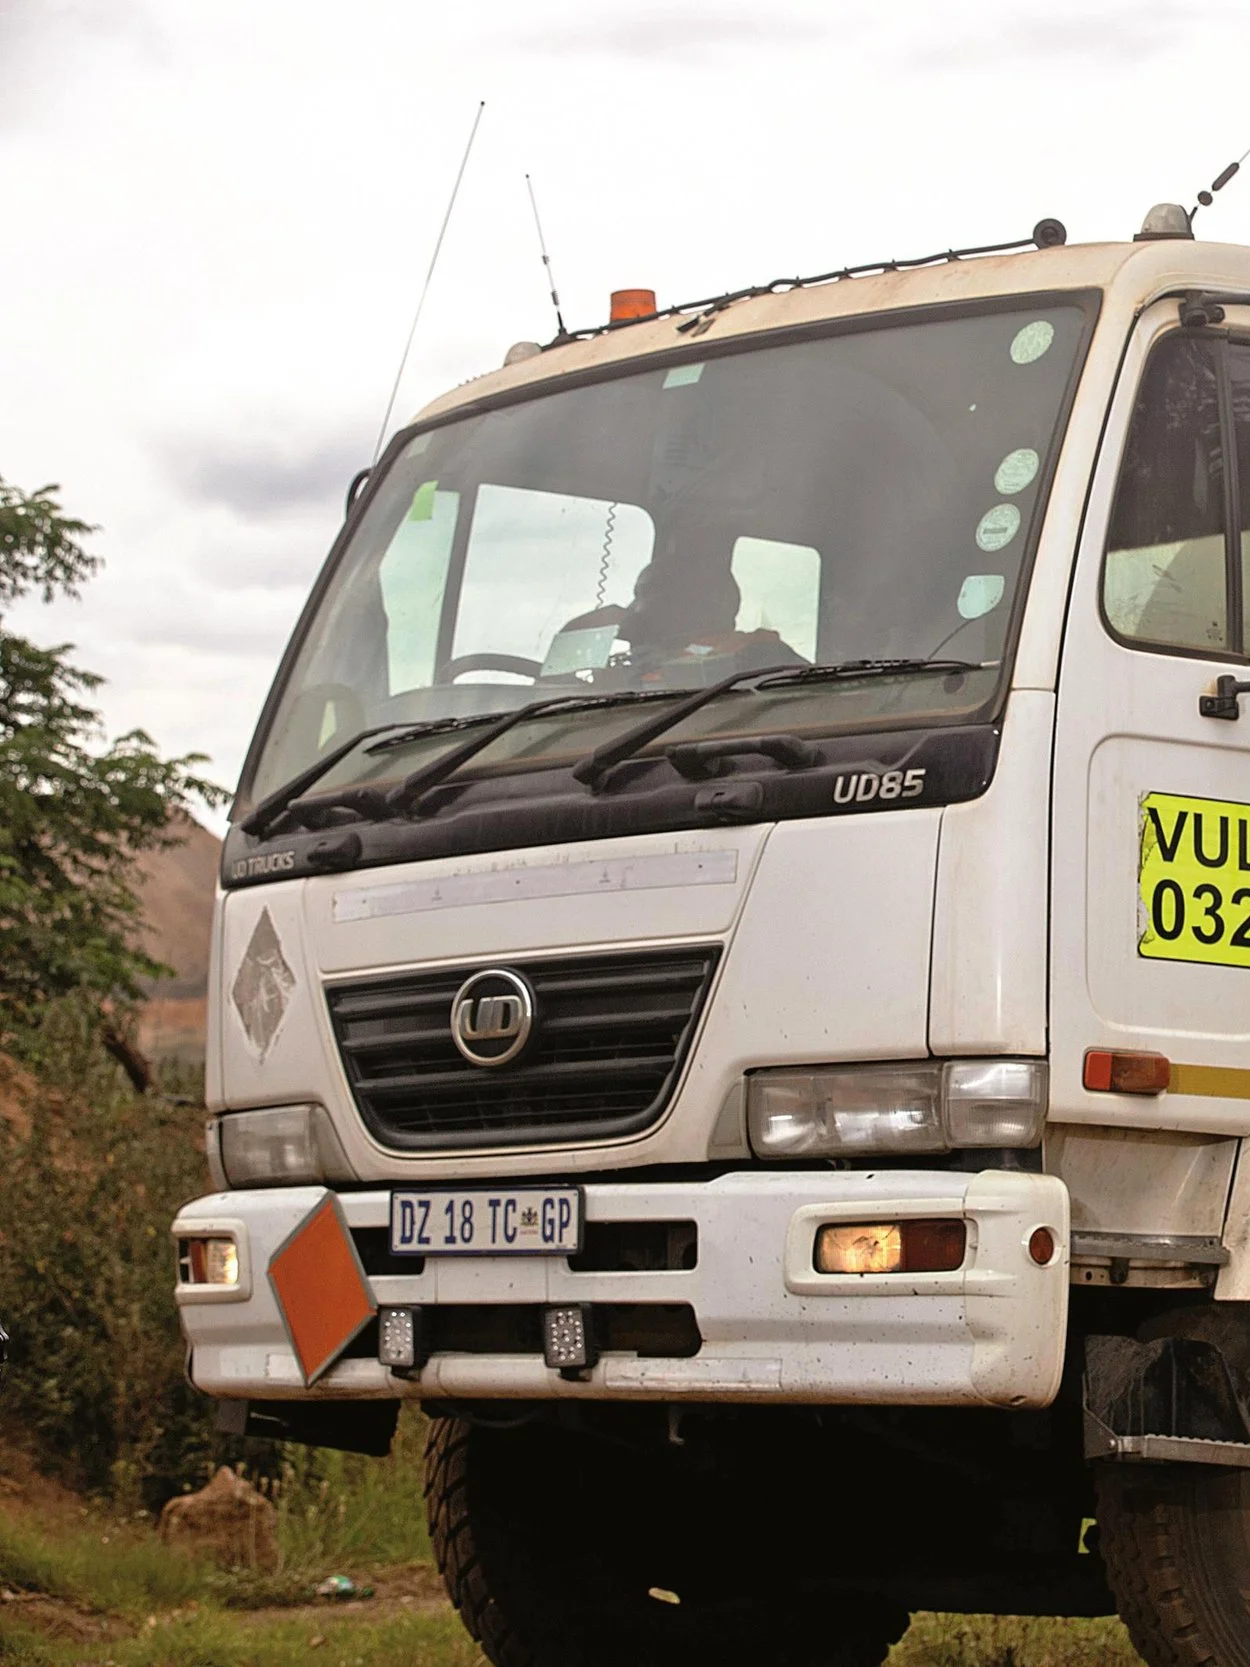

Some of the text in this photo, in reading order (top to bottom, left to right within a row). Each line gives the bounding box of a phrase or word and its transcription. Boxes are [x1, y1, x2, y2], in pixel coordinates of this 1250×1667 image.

[833, 768, 926, 804] UD85
[248, 850, 296, 877] TRUCKS
[457, 995, 523, 1041] UD
[400, 1197, 571, 1245] DZ 18 TC GP
